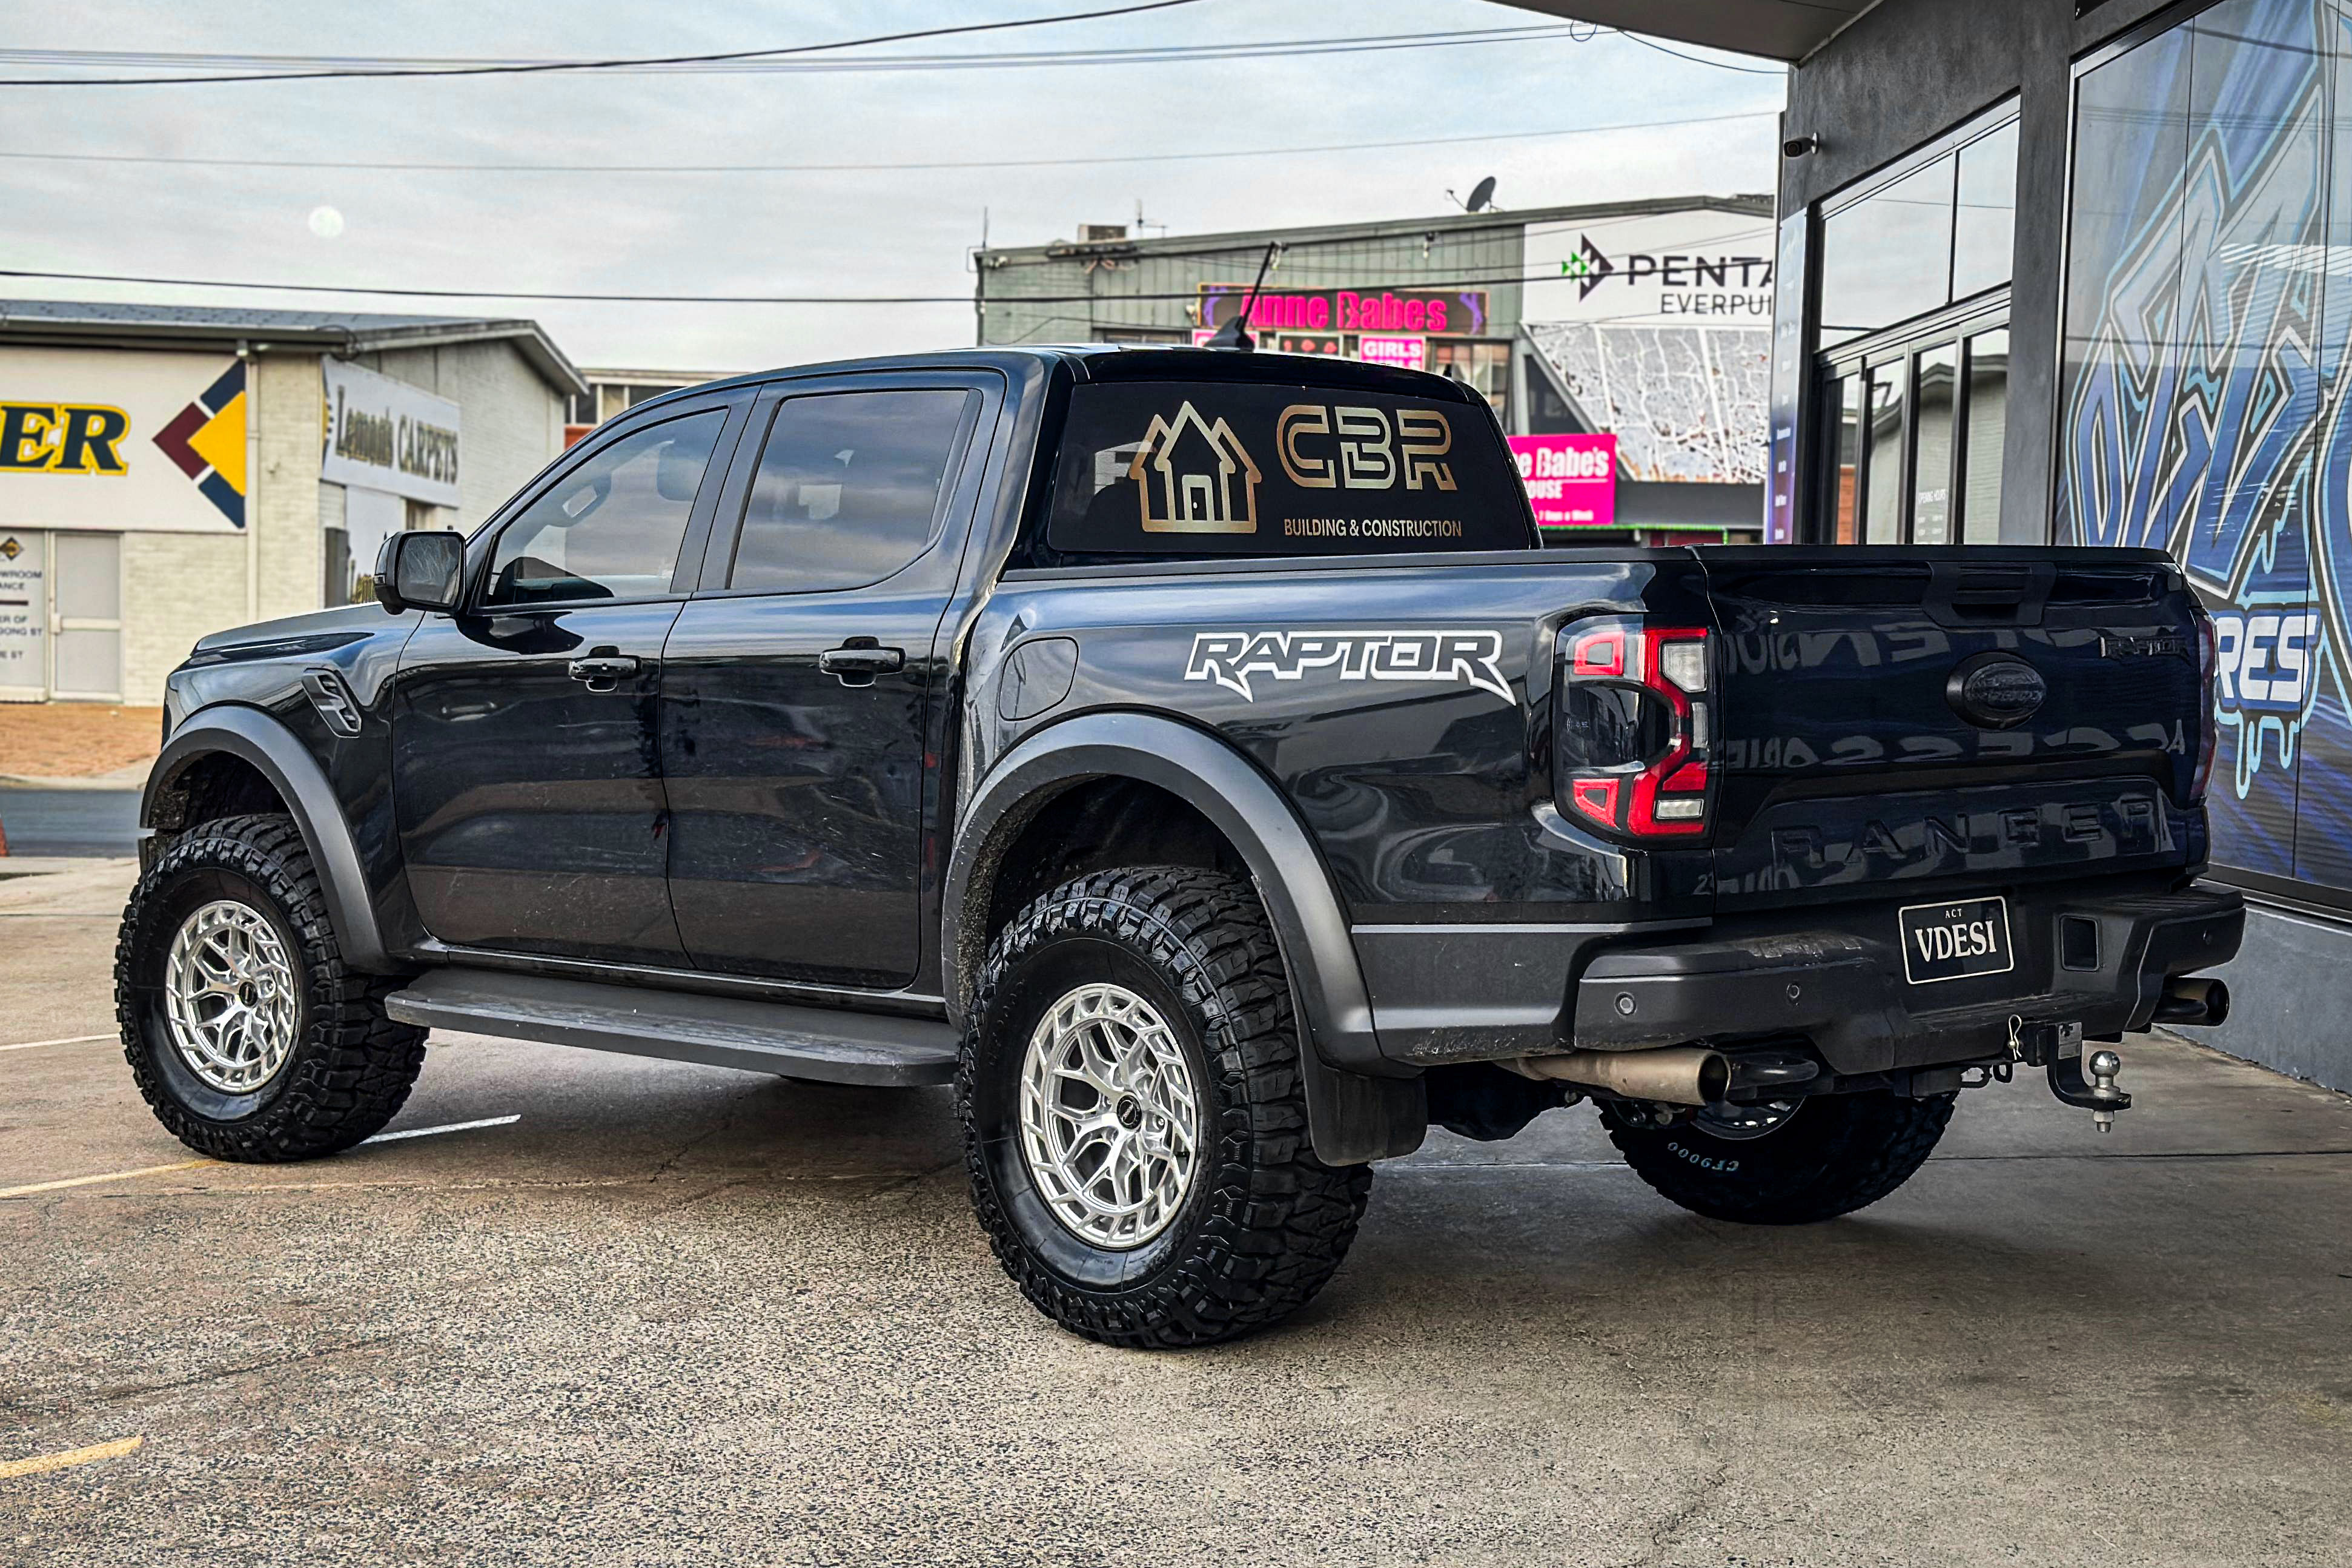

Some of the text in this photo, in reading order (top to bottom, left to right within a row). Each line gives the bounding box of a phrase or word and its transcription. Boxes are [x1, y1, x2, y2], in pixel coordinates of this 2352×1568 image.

[1337, 291, 1448, 331] Babes
[1661, 293, 1772, 316] EVERPU
[1363, 340, 1422, 357] GIRLS
[0, 402, 130, 476] ER
[1276, 405, 1458, 491] CBR
[1284, 518, 1462, 538] BUILDING & CONSTRUCTION
[1184, 630, 1516, 707] RAPTOR
[1945, 908, 1963, 919] ACT
[1915, 920, 1997, 962] VDESI
